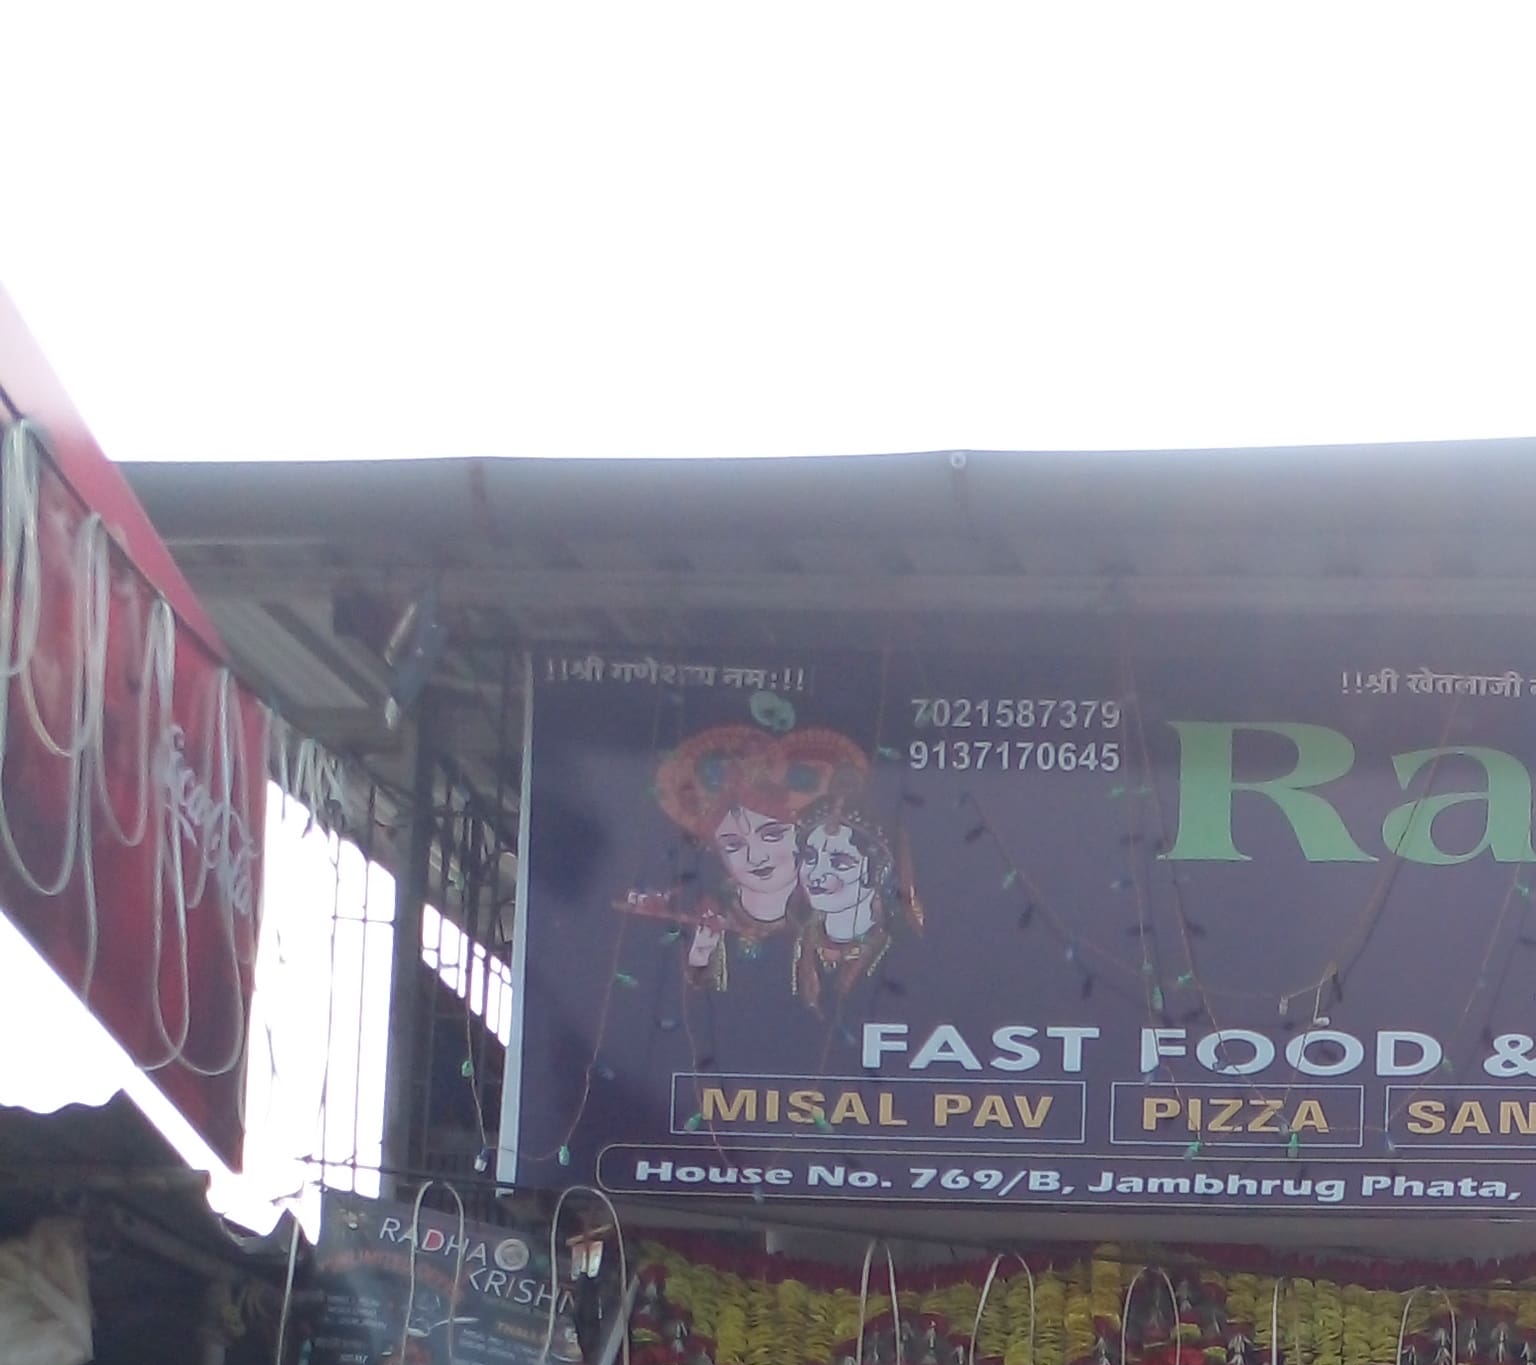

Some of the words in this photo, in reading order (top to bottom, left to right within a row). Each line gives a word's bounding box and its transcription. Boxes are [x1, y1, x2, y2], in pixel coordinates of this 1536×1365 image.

[910, 698, 1121, 729] 7021587379
[908, 740, 1121, 771] 9137170645
[861, 1023, 1100, 1074] FAST
[1140, 1027, 1444, 1078] FOOD
[701, 1086, 909, 1127] MISAL
[932, 1091, 1055, 1129] PAV
[1140, 1096, 1331, 1135] PIZZA
[634, 1160, 793, 1188] House
[807, 1161, 894, 1190] No.
[909, 1167, 1075, 1198] 769/B,
[1087, 1169, 1346, 1202] Jambhrug
[1361, 1174, 1522, 1203] Phata,
[379, 1217, 488, 1266] RADHA
